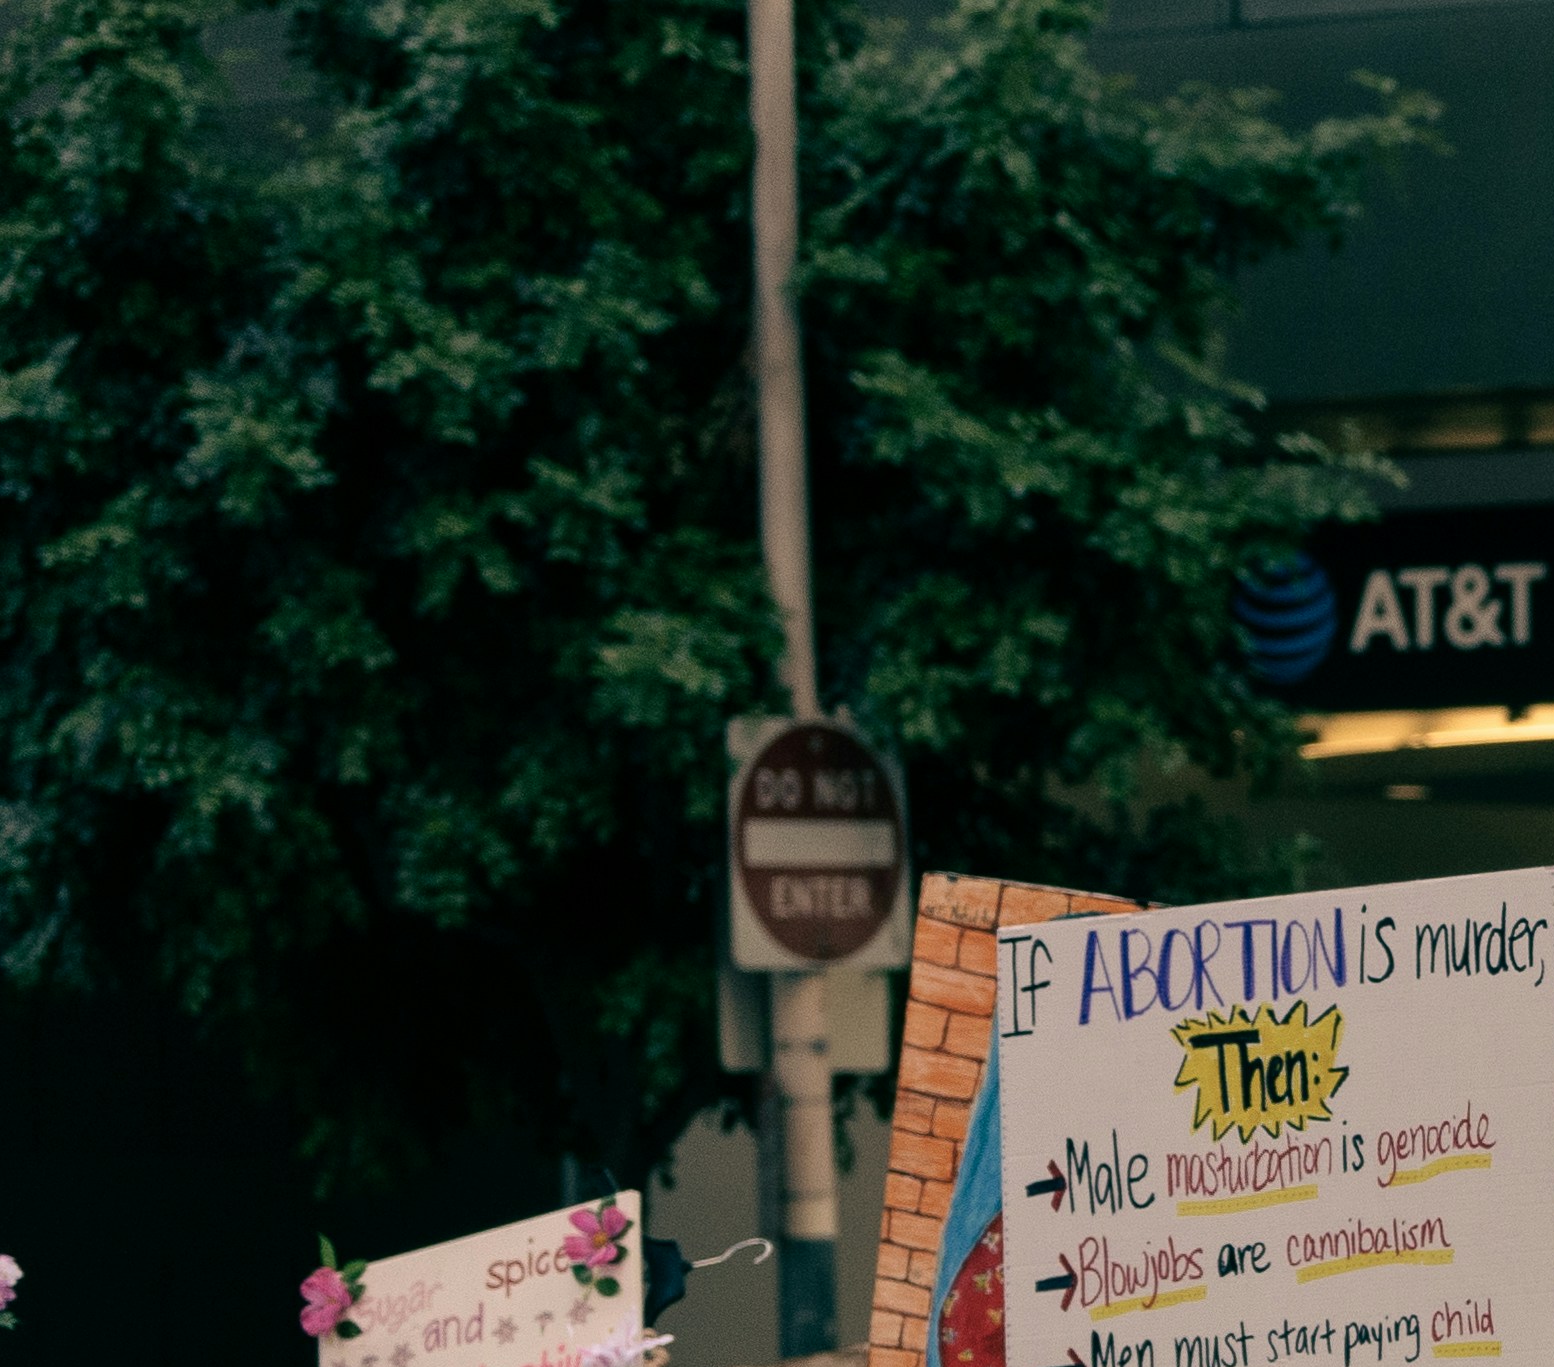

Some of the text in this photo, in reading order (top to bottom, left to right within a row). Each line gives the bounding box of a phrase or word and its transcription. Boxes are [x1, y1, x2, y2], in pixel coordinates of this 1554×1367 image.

[1350, 562, 1548, 654] AT&T
[754, 767, 876, 810] DO NOT
[770, 876, 873, 919] ENTER
[1001, 902, 1548, 1038] If ABORTION is murder,
[1189, 1030, 1321, 1113] Then:
[1066, 1101, 1497, 1216] Male masturbation is genocide
[486, 1236, 572, 1297] spice
[1077, 1216, 1452, 1309] Blowjobs are cannibalism
[422, 1302, 485, 1352] and
[1267, 1319, 1336, 1364] start
[1431, 1299, 1495, 1343] child
